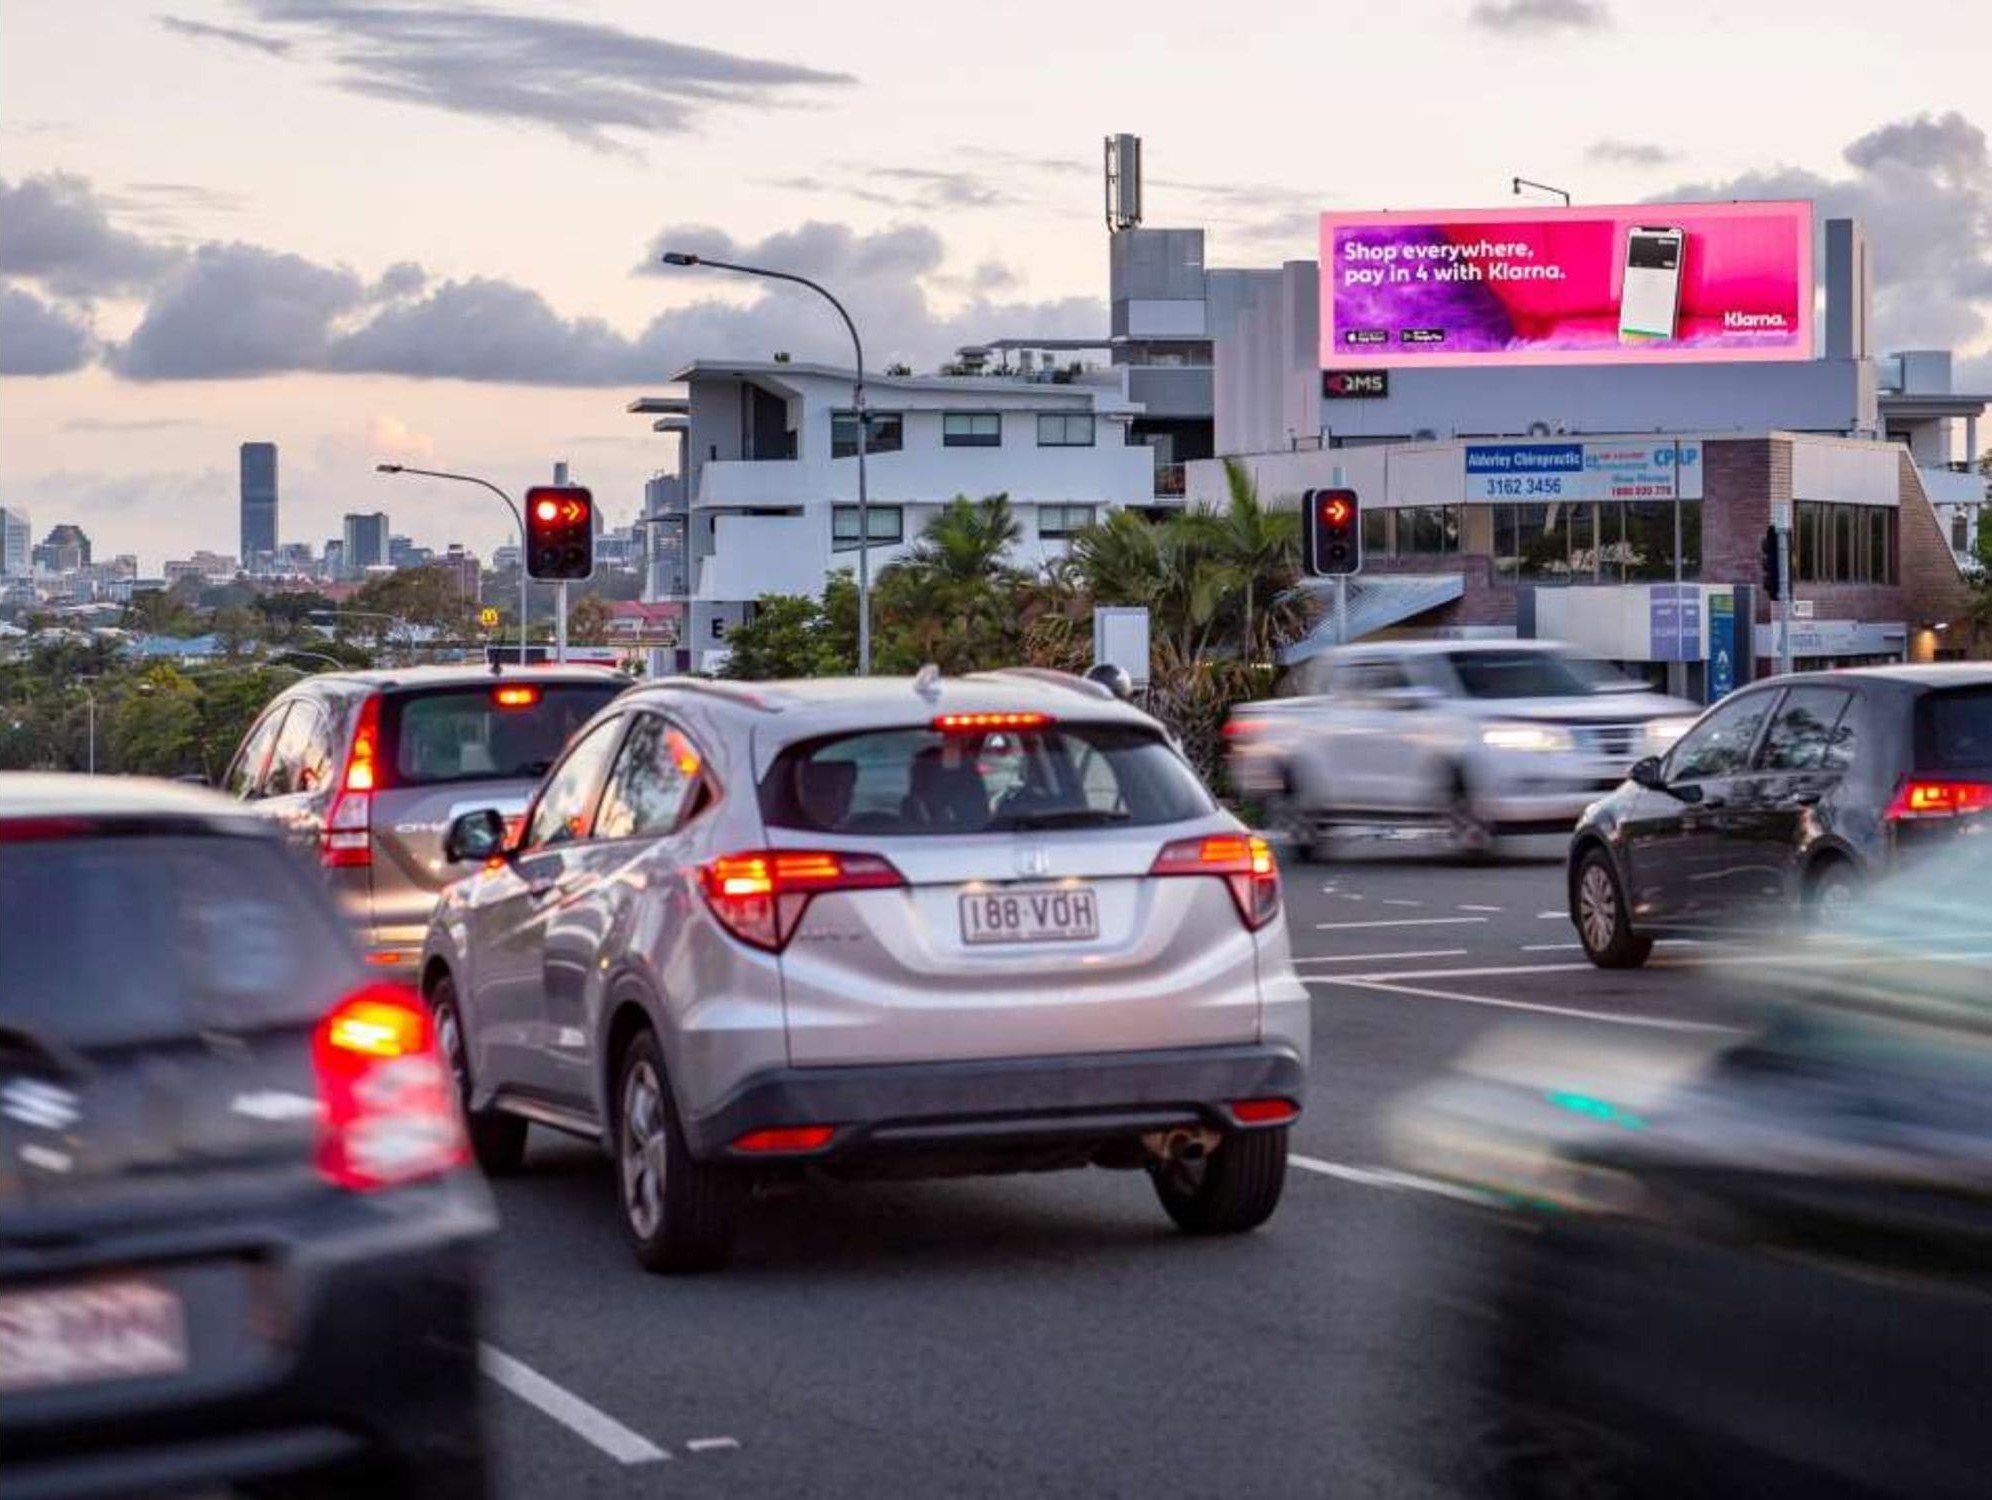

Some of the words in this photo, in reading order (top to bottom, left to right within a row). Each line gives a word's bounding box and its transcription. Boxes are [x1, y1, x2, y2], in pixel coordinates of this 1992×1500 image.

[1344, 241, 1397, 264] Shop
[1402, 240, 1534, 262] everywhere,
[1345, 268, 1385, 286] pay
[1390, 264, 1410, 282] in
[1416, 263, 1428, 281] 4
[1433, 262, 1482, 281] with
[1488, 261, 1566, 281] Klarna.
[1724, 310, 1788, 327] Klarna.
[1514, 449, 1580, 468] Chiropractic
[1487, 478, 1522, 496] 3162
[1526, 477, 1562, 495] 3456
[711, 618, 724, 640] E
[971, 897, 1020, 930] 188
[1030, 893, 1092, 928] VOH
